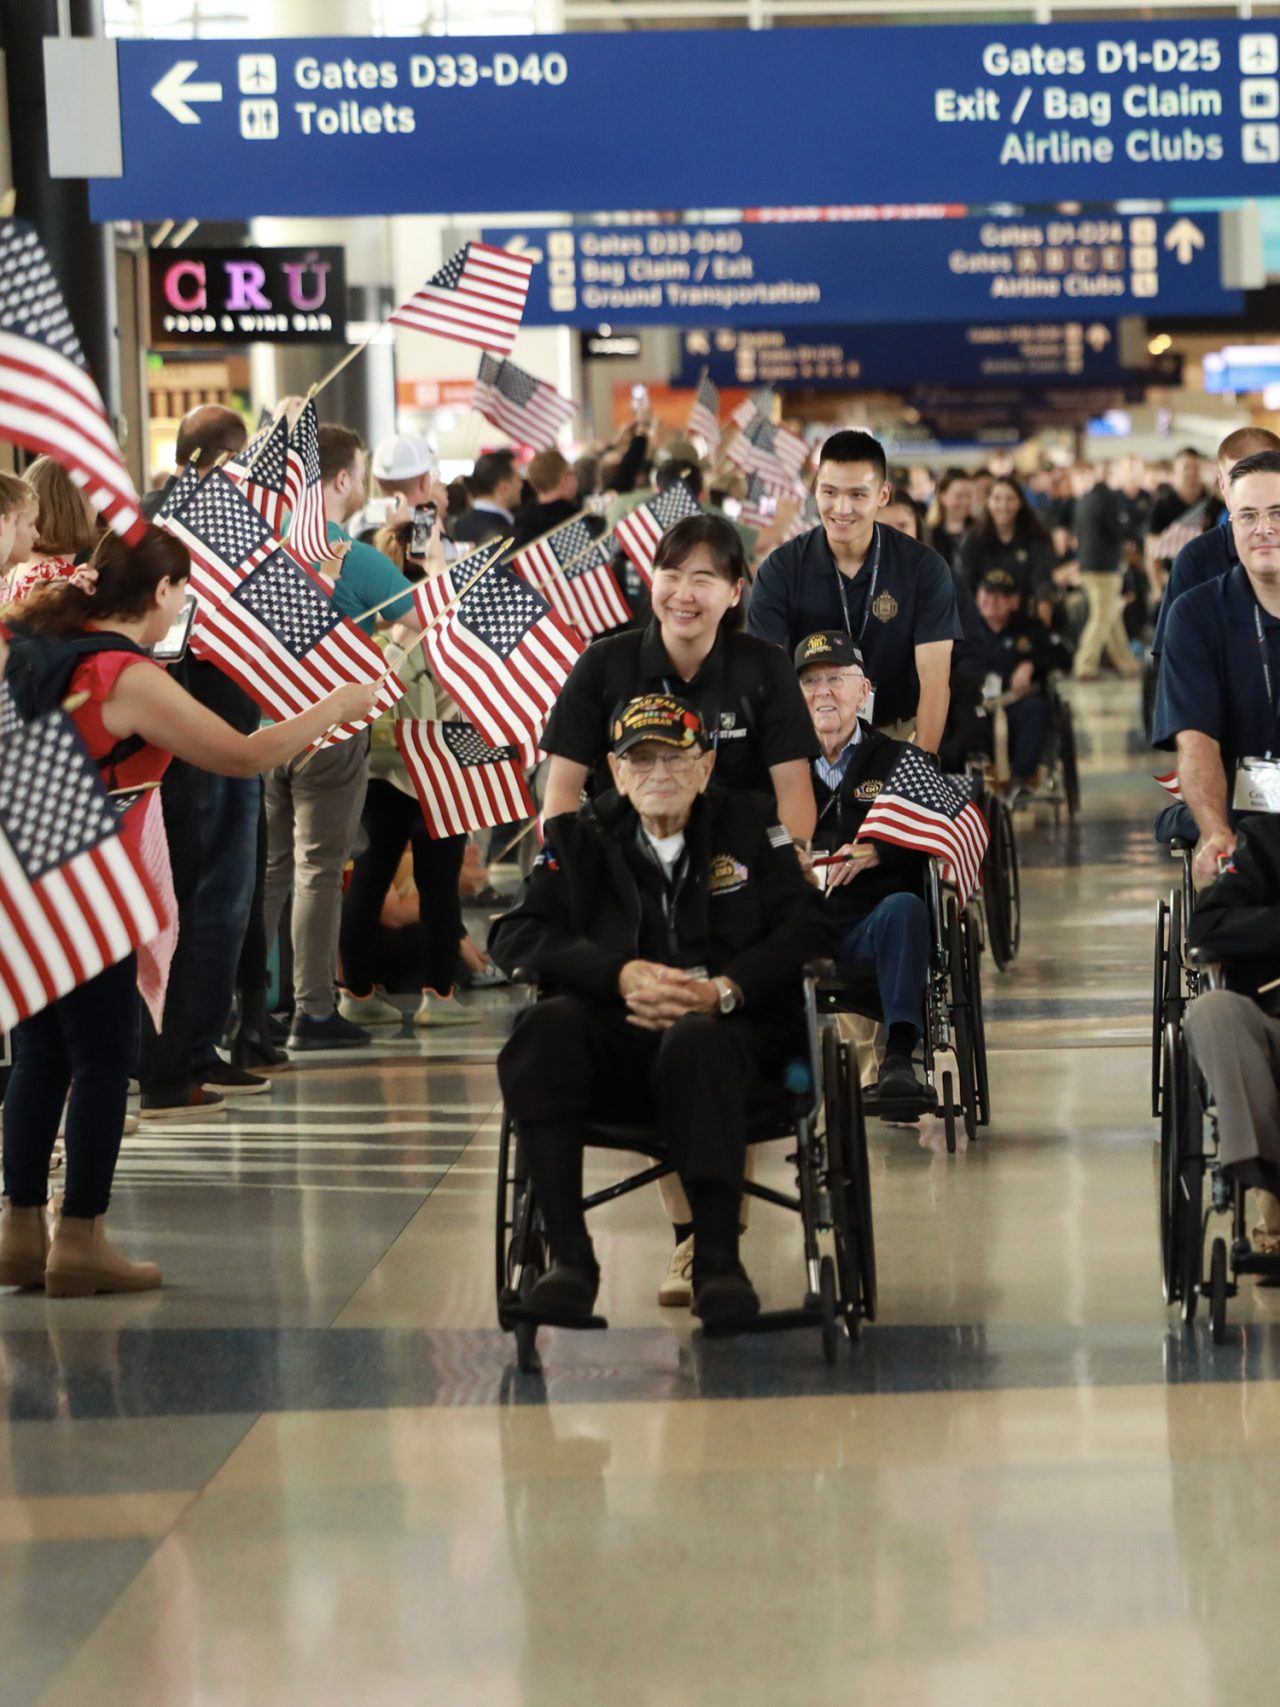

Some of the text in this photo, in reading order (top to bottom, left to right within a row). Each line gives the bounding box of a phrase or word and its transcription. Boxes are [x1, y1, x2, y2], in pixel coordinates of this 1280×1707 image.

[295, 52, 568, 90] Gates D33-D40
[982, 38, 1222, 77] Gates D1-D25
[295, 99, 416, 135] Toilets
[934, 82, 1223, 127] Exit / Bag Claim
[999, 127, 1224, 165] Airline Clubs
[580, 231, 644, 257] Gates
[980, 223, 1044, 248] Gates
[581, 258, 625, 286] Bag
[628, 257, 690, 280] Claim
[713, 255, 753, 279] Exit
[949, 250, 1013, 274] Gates
[581, 282, 821, 309] Ground Transportation
[991, 275, 1125, 298] Airline Clubs
[164, 314, 217, 333] FOOD
[238, 314, 289, 332] WINE
[292, 313, 333, 332] BAR
[655, 698, 677, 710] WAR
